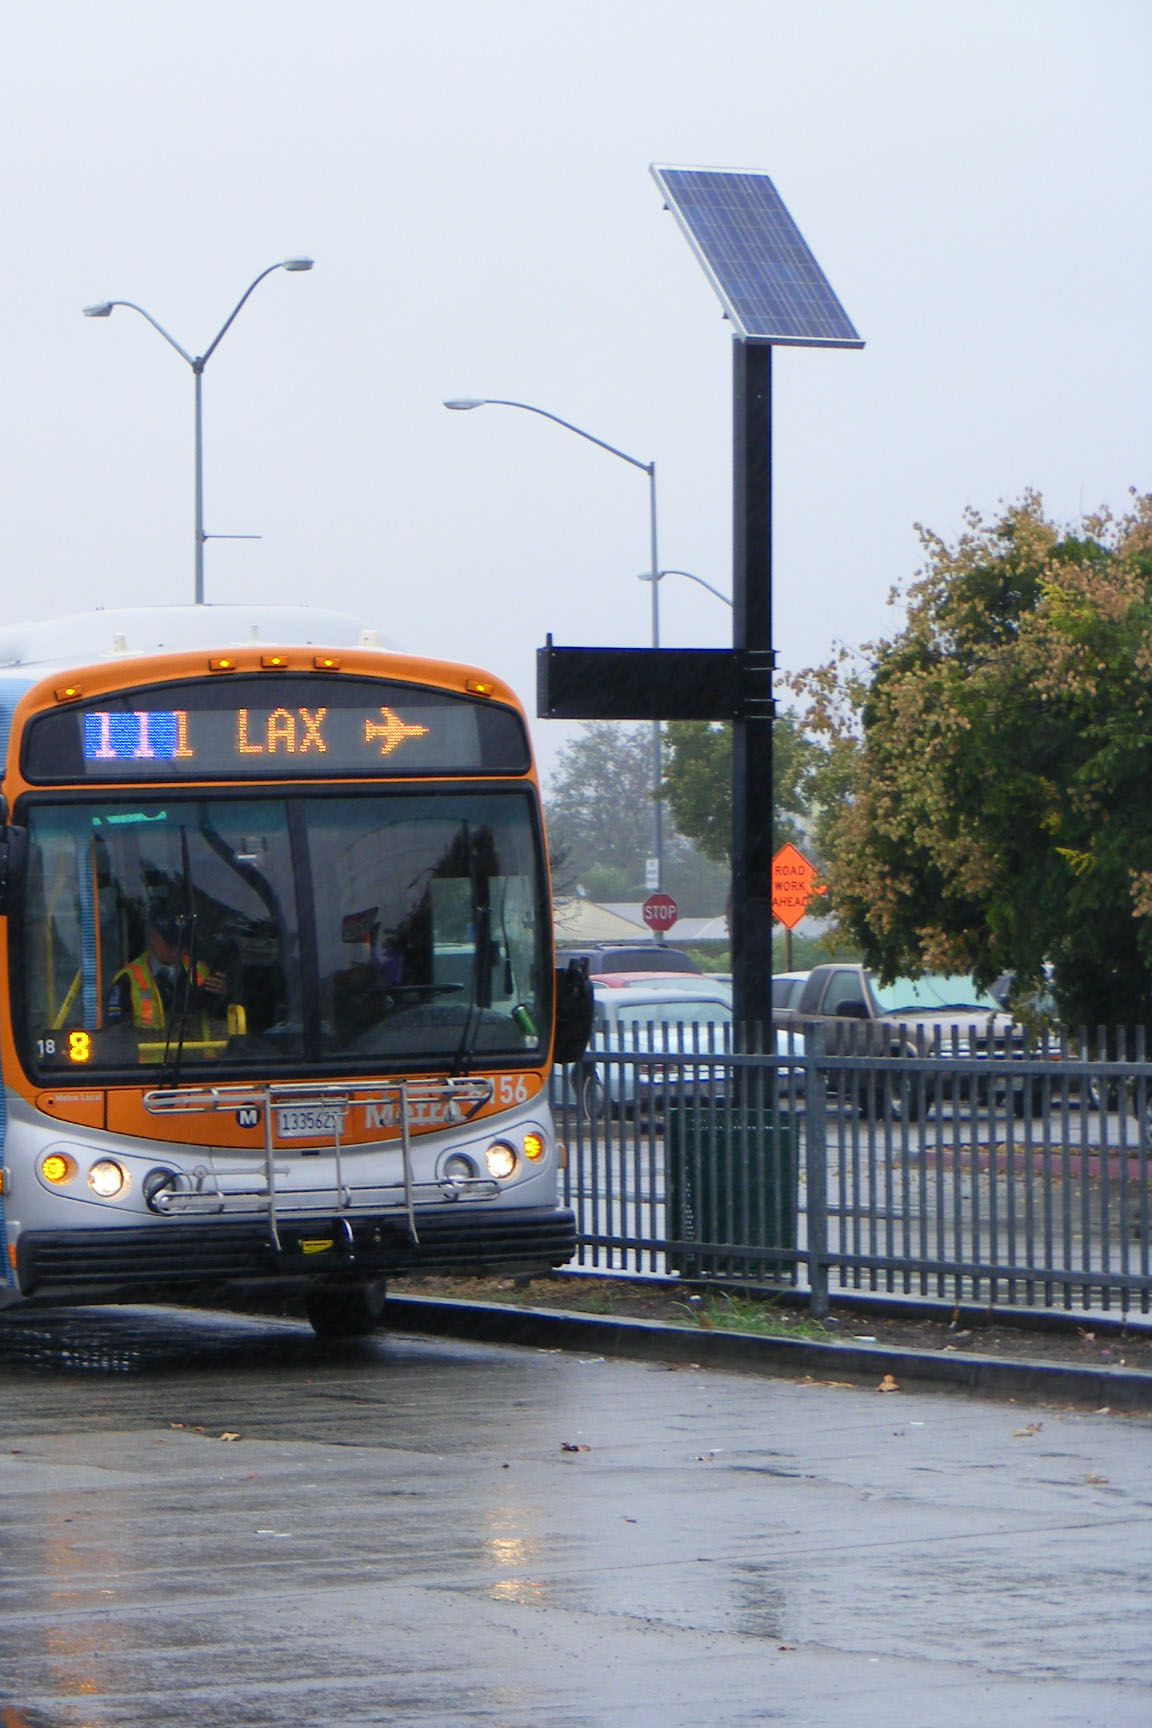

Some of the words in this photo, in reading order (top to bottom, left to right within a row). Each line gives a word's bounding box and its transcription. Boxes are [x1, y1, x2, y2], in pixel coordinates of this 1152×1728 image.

[94, 710, 194, 758] 111
[238, 707, 327, 754] LAX
[775, 866, 806, 876] ROAD
[775, 882, 806, 892] WORK
[645, 905, 676, 920] STOP
[37, 1039, 56, 1055] 18
[69, 1031, 89, 1061] 8
[468, 1076, 528, 1106] 156
